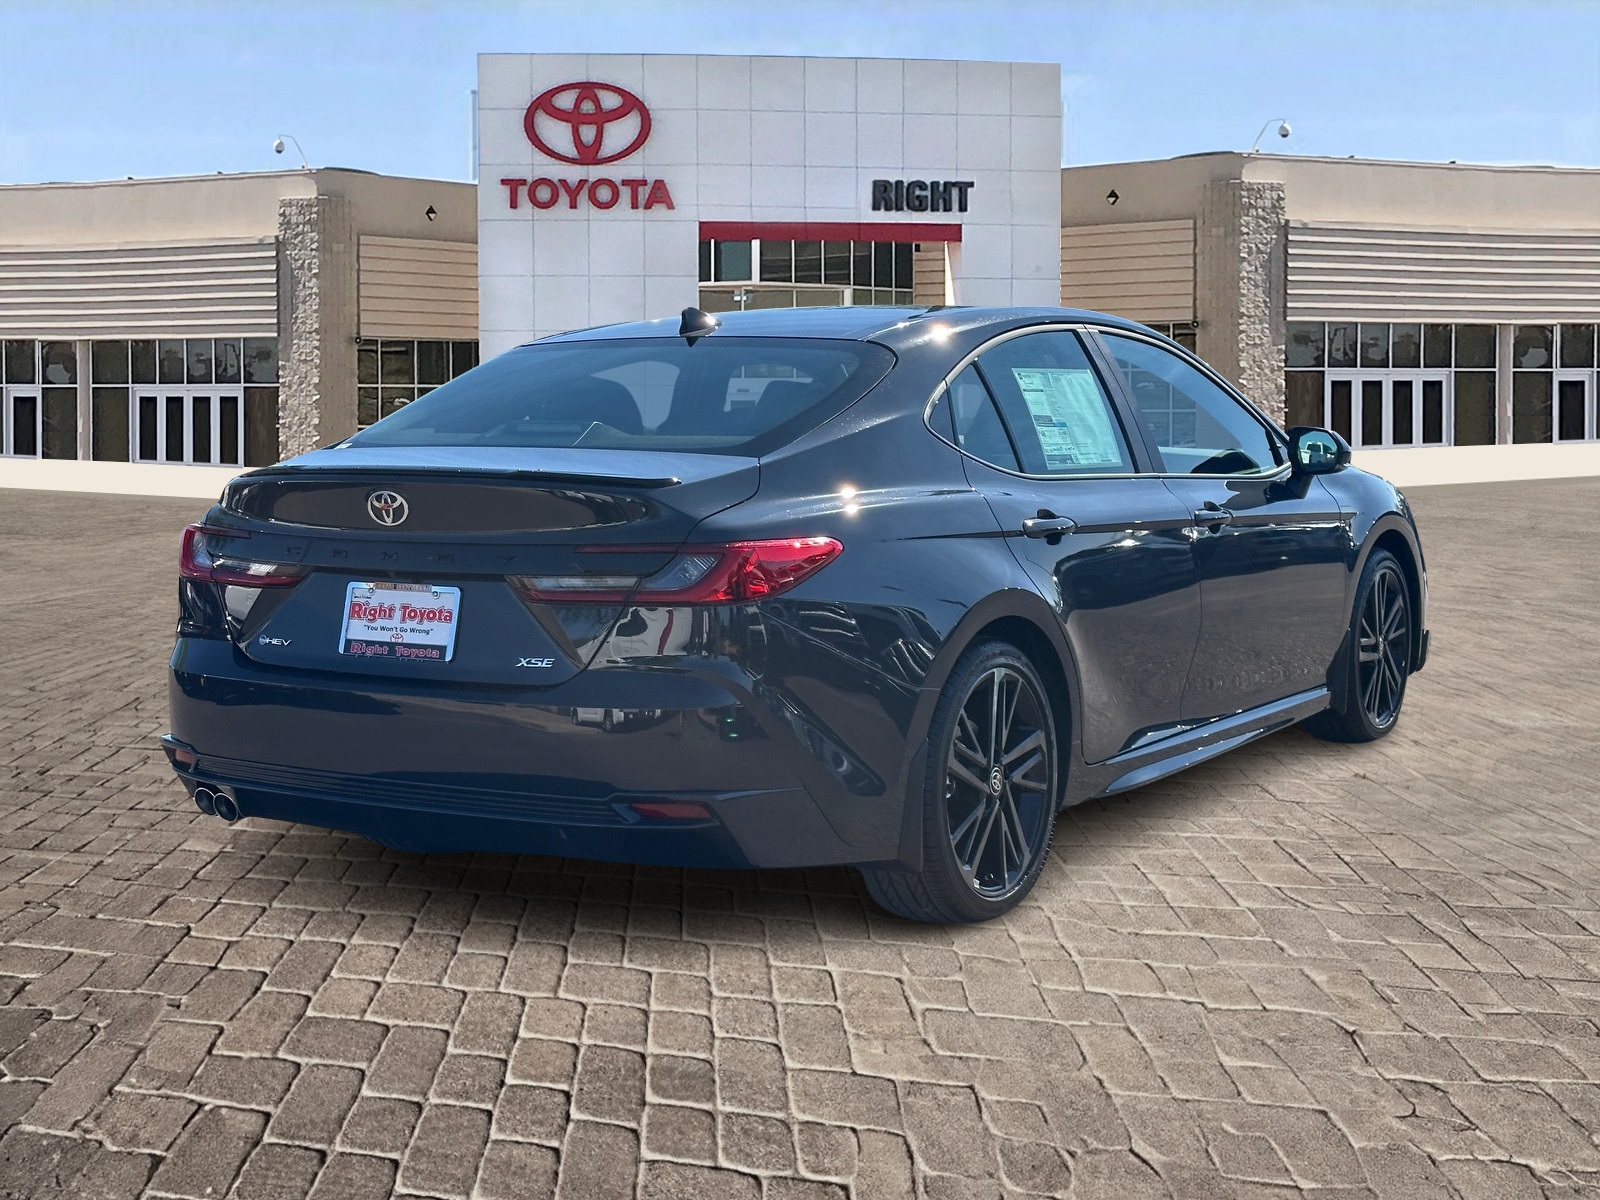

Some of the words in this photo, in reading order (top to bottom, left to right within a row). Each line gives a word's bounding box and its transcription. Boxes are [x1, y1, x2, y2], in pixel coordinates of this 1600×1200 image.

[500, 177, 675, 210] TOYOTA
[872, 180, 974, 212] RIGHT
[350, 601, 396, 622] Right
[399, 603, 453, 624] Toyota
[379, 625, 398, 633] Won't
[350, 642, 389, 655] Right
[395, 645, 440, 658] Toyota
[515, 657, 556, 668] XSE
